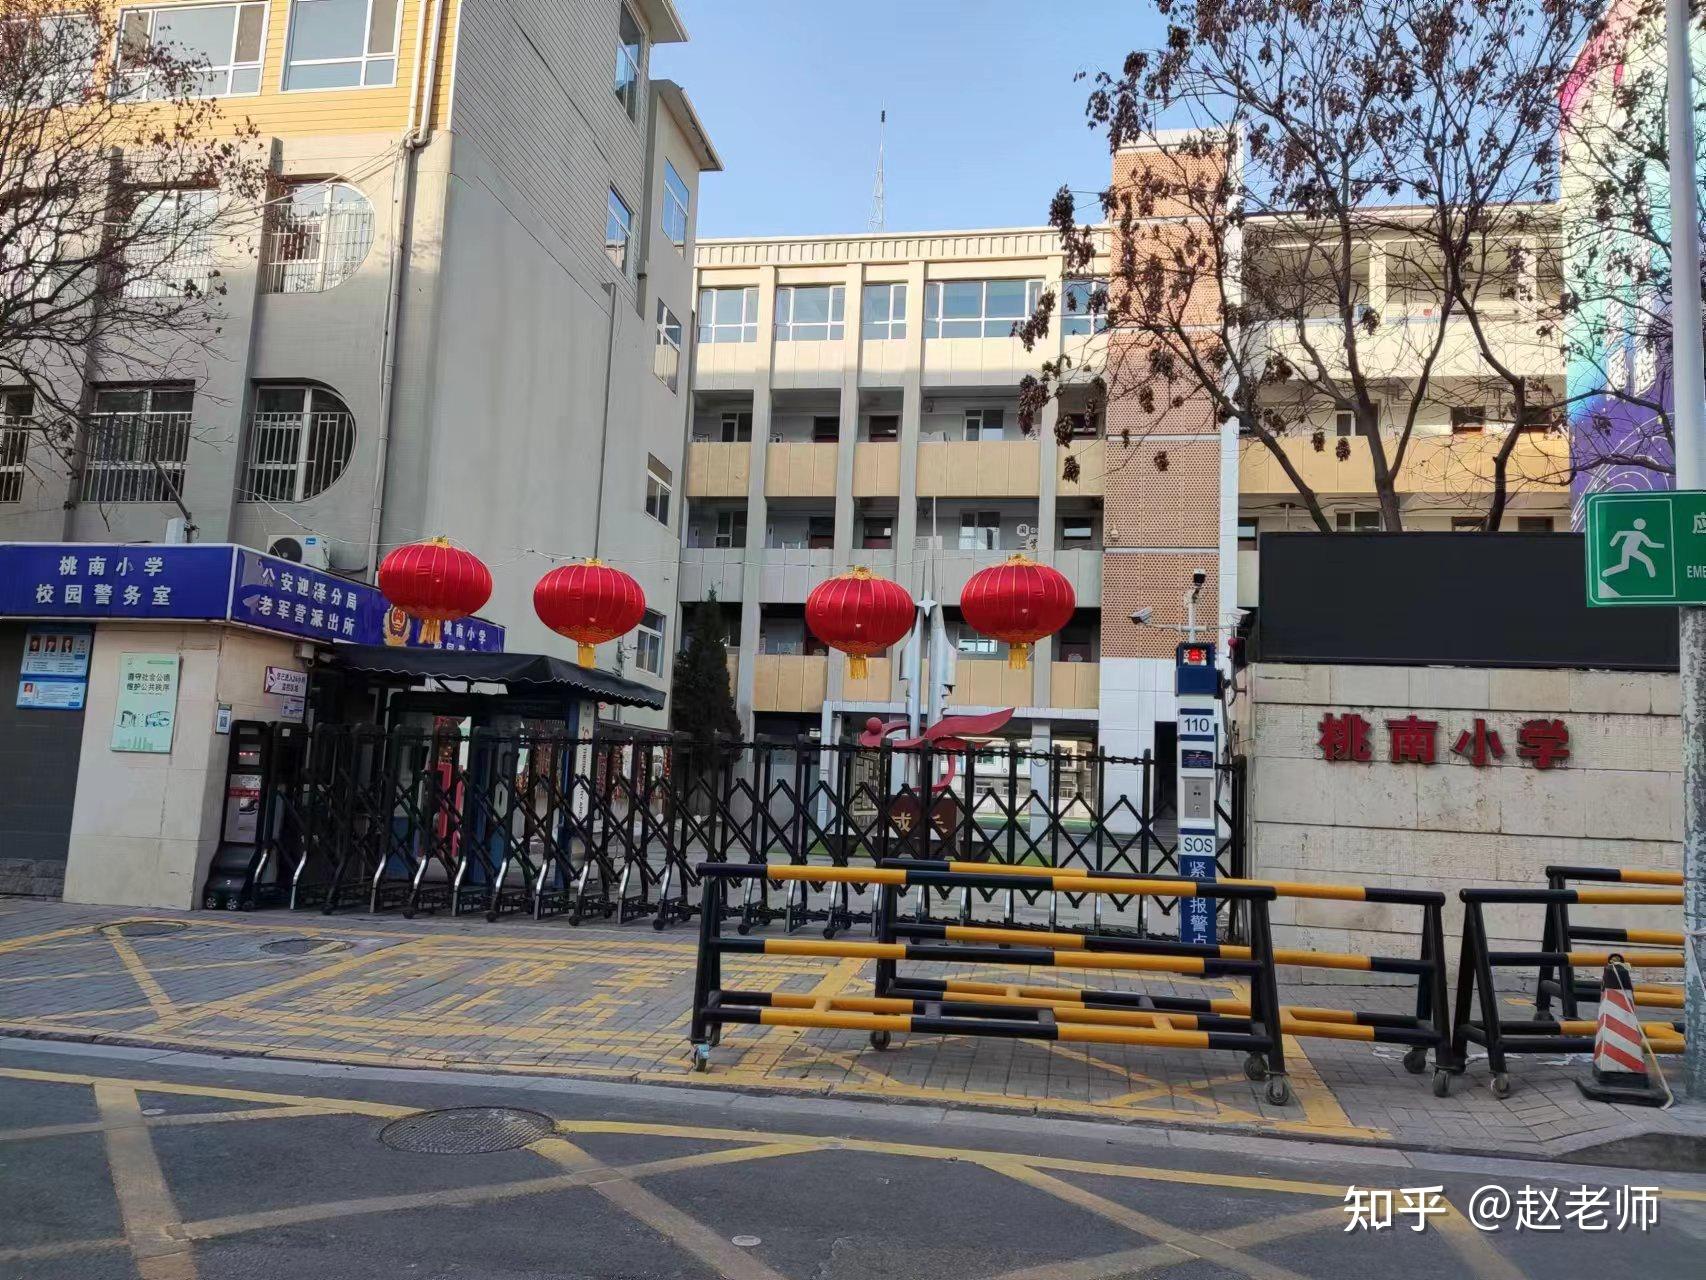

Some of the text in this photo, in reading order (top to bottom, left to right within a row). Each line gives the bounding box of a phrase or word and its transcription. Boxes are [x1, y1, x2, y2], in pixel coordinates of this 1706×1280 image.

[58, 555, 164, 577] 桃南小学
[35, 583, 172, 606] 校园警务室
[258, 595, 356, 636] 老军营派出所
[1184, 717, 1210, 733] 110
[1316, 712, 1571, 770] 桃南小学
[1183, 837, 1213, 853] SOS
[1189, 860, 1209, 945] 紧报警点
